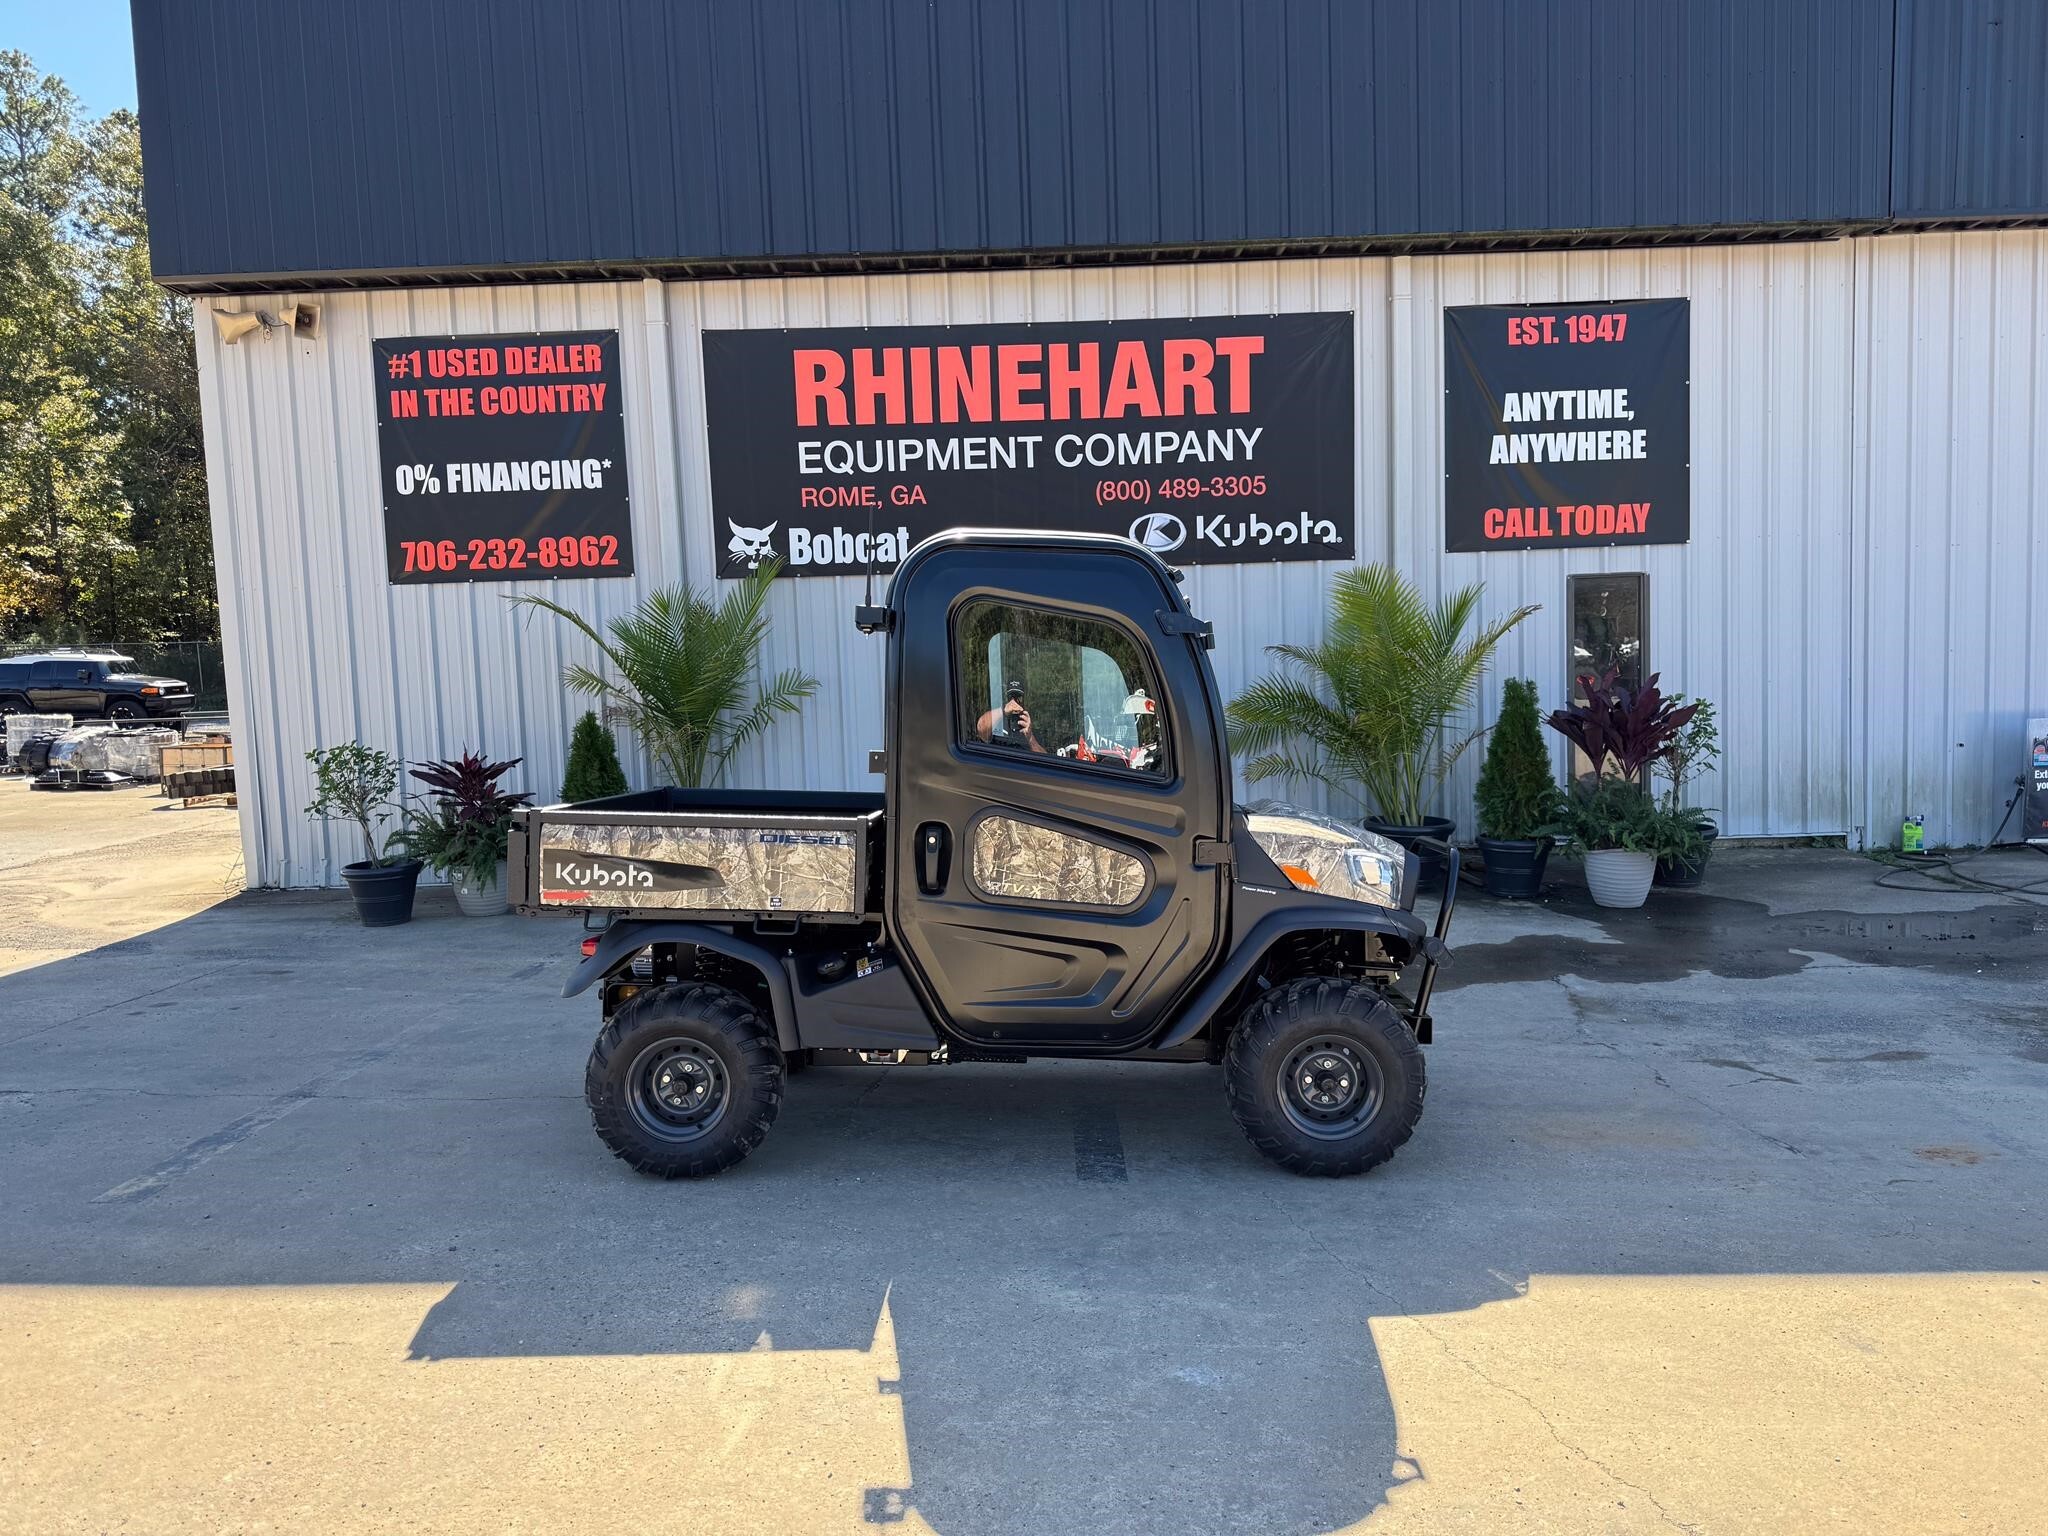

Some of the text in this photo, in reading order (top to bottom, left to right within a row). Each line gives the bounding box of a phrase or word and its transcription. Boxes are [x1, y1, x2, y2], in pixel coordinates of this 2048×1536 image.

[1507, 313, 1628, 346] EST. 1947
[388, 344, 601, 379] #1 USED DEALER
[793, 335, 1265, 427] RHINEHART
[390, 383, 607, 418] IN THE COUNTRY
[1502, 388, 1635, 423] ANYTIME,
[797, 427, 1264, 476] EQUIPMENT COMPANY
[1489, 429, 1647, 465] ANYWHERE
[395, 464, 440, 495] 0%
[801, 484, 927, 509] ROME, GA
[1095, 475, 1267, 506] (800) 489-3305
[1483, 502, 1651, 540] CALL TODAY
[400, 535, 619, 572] 706-232-8962
[788, 526, 910, 565] Bobcat
[760, 834, 853, 846] DIESEL
[555, 862, 653, 888] Kubota
